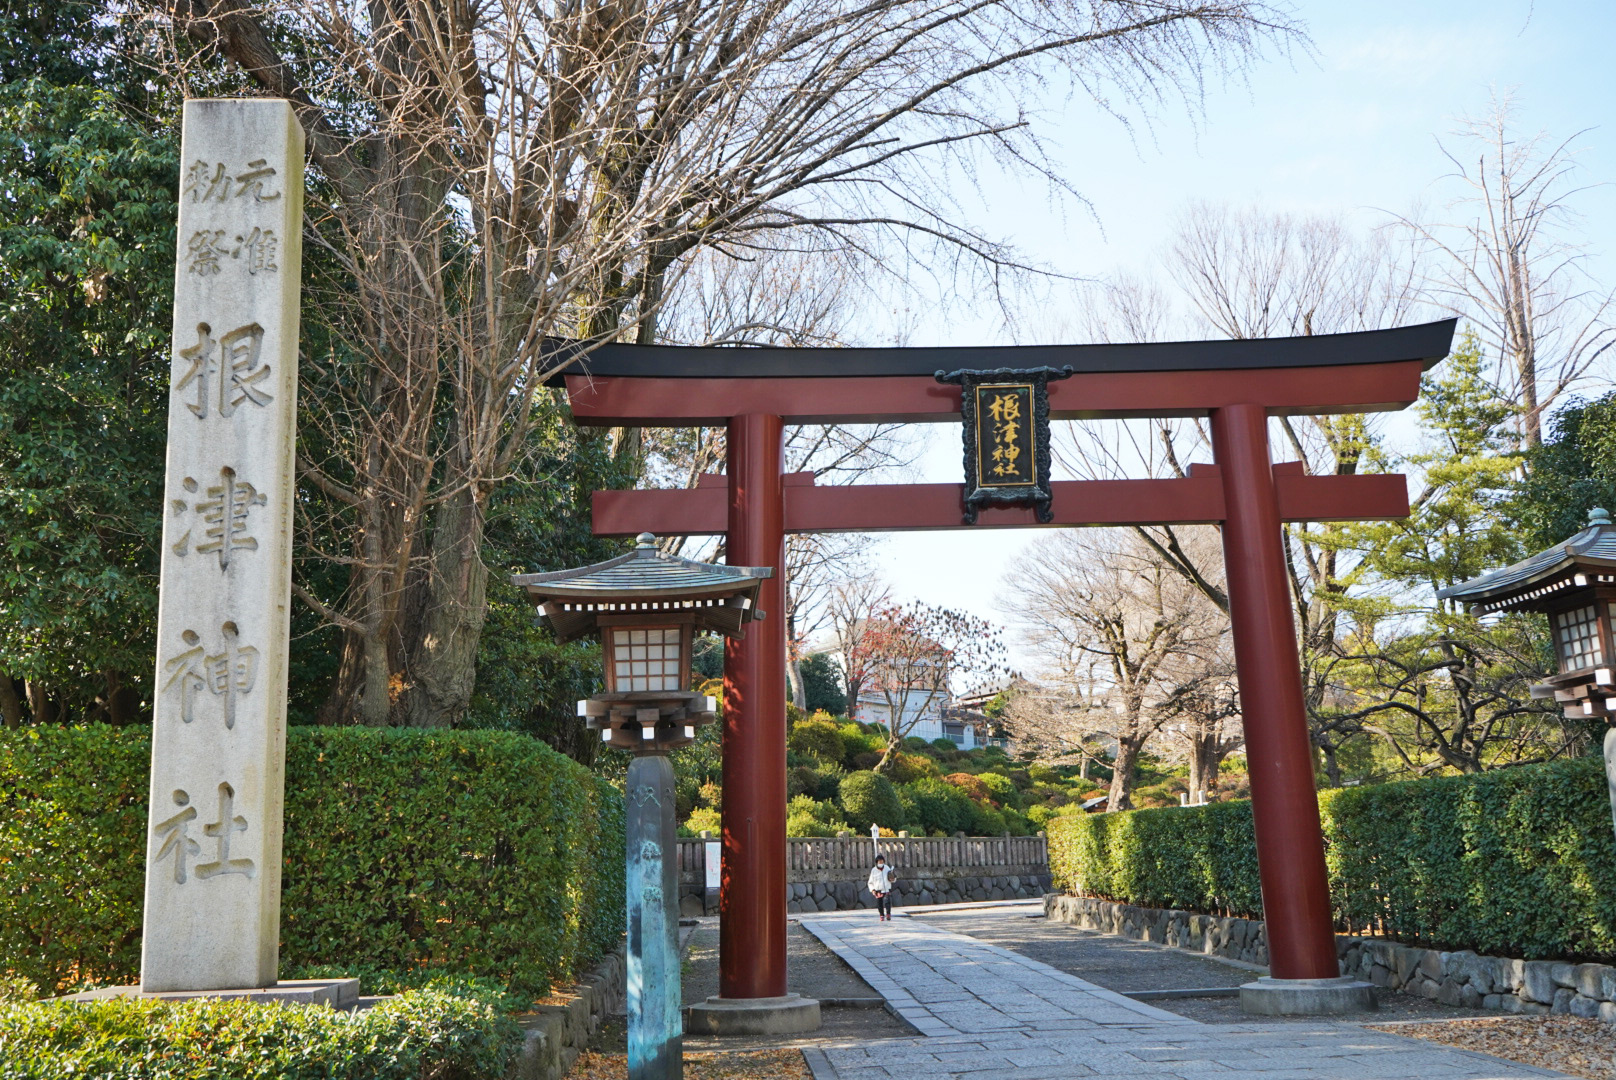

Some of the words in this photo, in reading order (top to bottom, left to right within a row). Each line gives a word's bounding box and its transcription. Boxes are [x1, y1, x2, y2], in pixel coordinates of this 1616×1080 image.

[987, 394, 1021, 477] 根津神社
[155, 322, 275, 884] 根津神社
